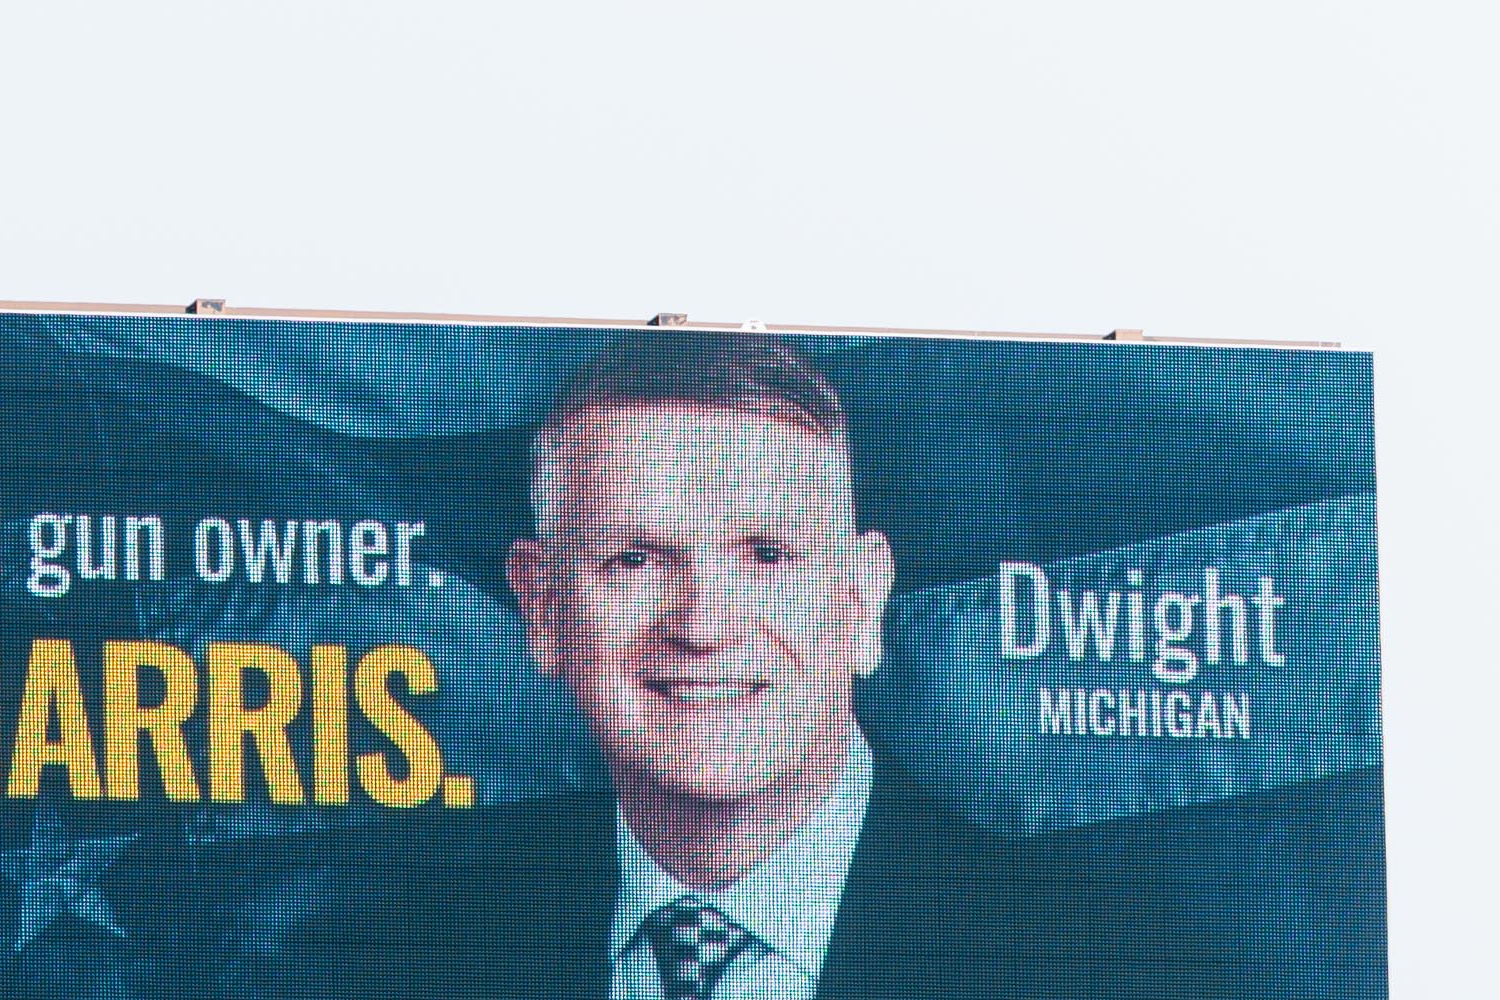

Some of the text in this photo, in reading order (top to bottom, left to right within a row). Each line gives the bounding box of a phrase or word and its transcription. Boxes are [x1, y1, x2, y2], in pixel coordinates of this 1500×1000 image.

[27, 513, 166, 598] gun
[195, 516, 446, 588] owner.
[1000, 561, 1286, 684] Dwight
[1039, 687, 1251, 739] MICHIGAN
